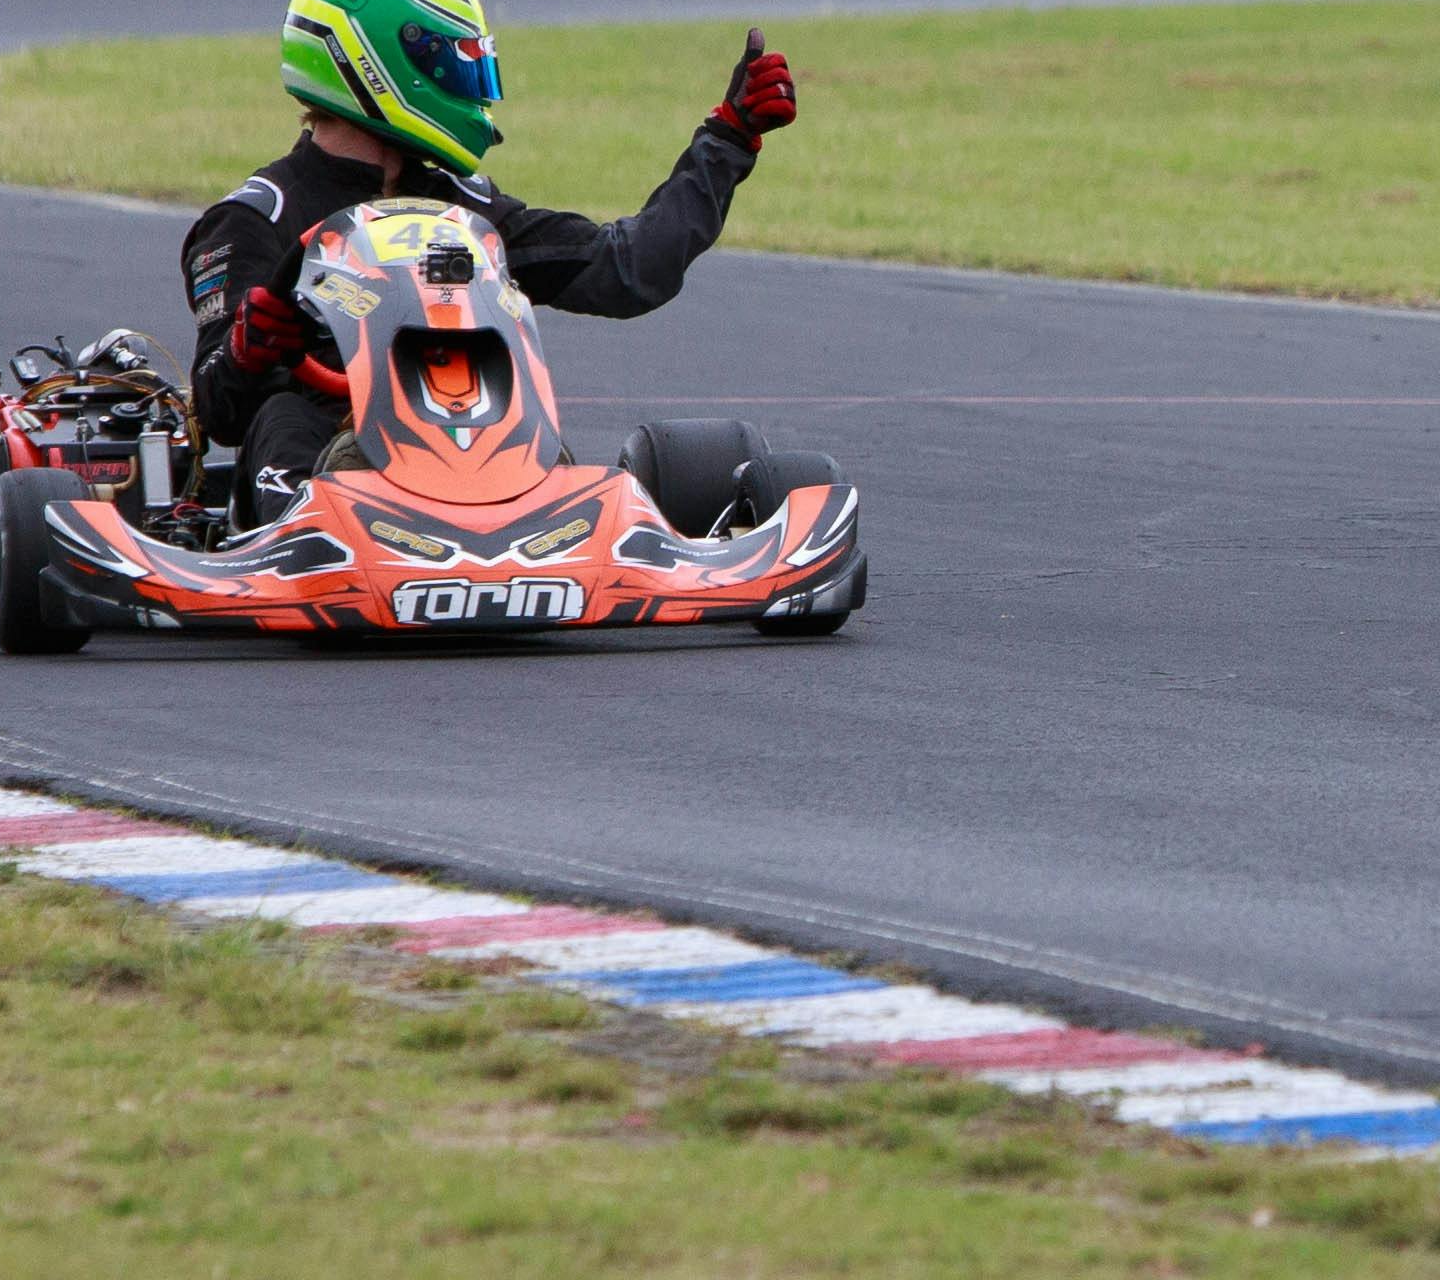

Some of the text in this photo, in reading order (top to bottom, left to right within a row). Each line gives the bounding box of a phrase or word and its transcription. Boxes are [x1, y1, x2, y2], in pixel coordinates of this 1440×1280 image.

[311, 272, 382, 320] CRG
[370, 519, 446, 557] CRG
[524, 518, 591, 556] CRG
